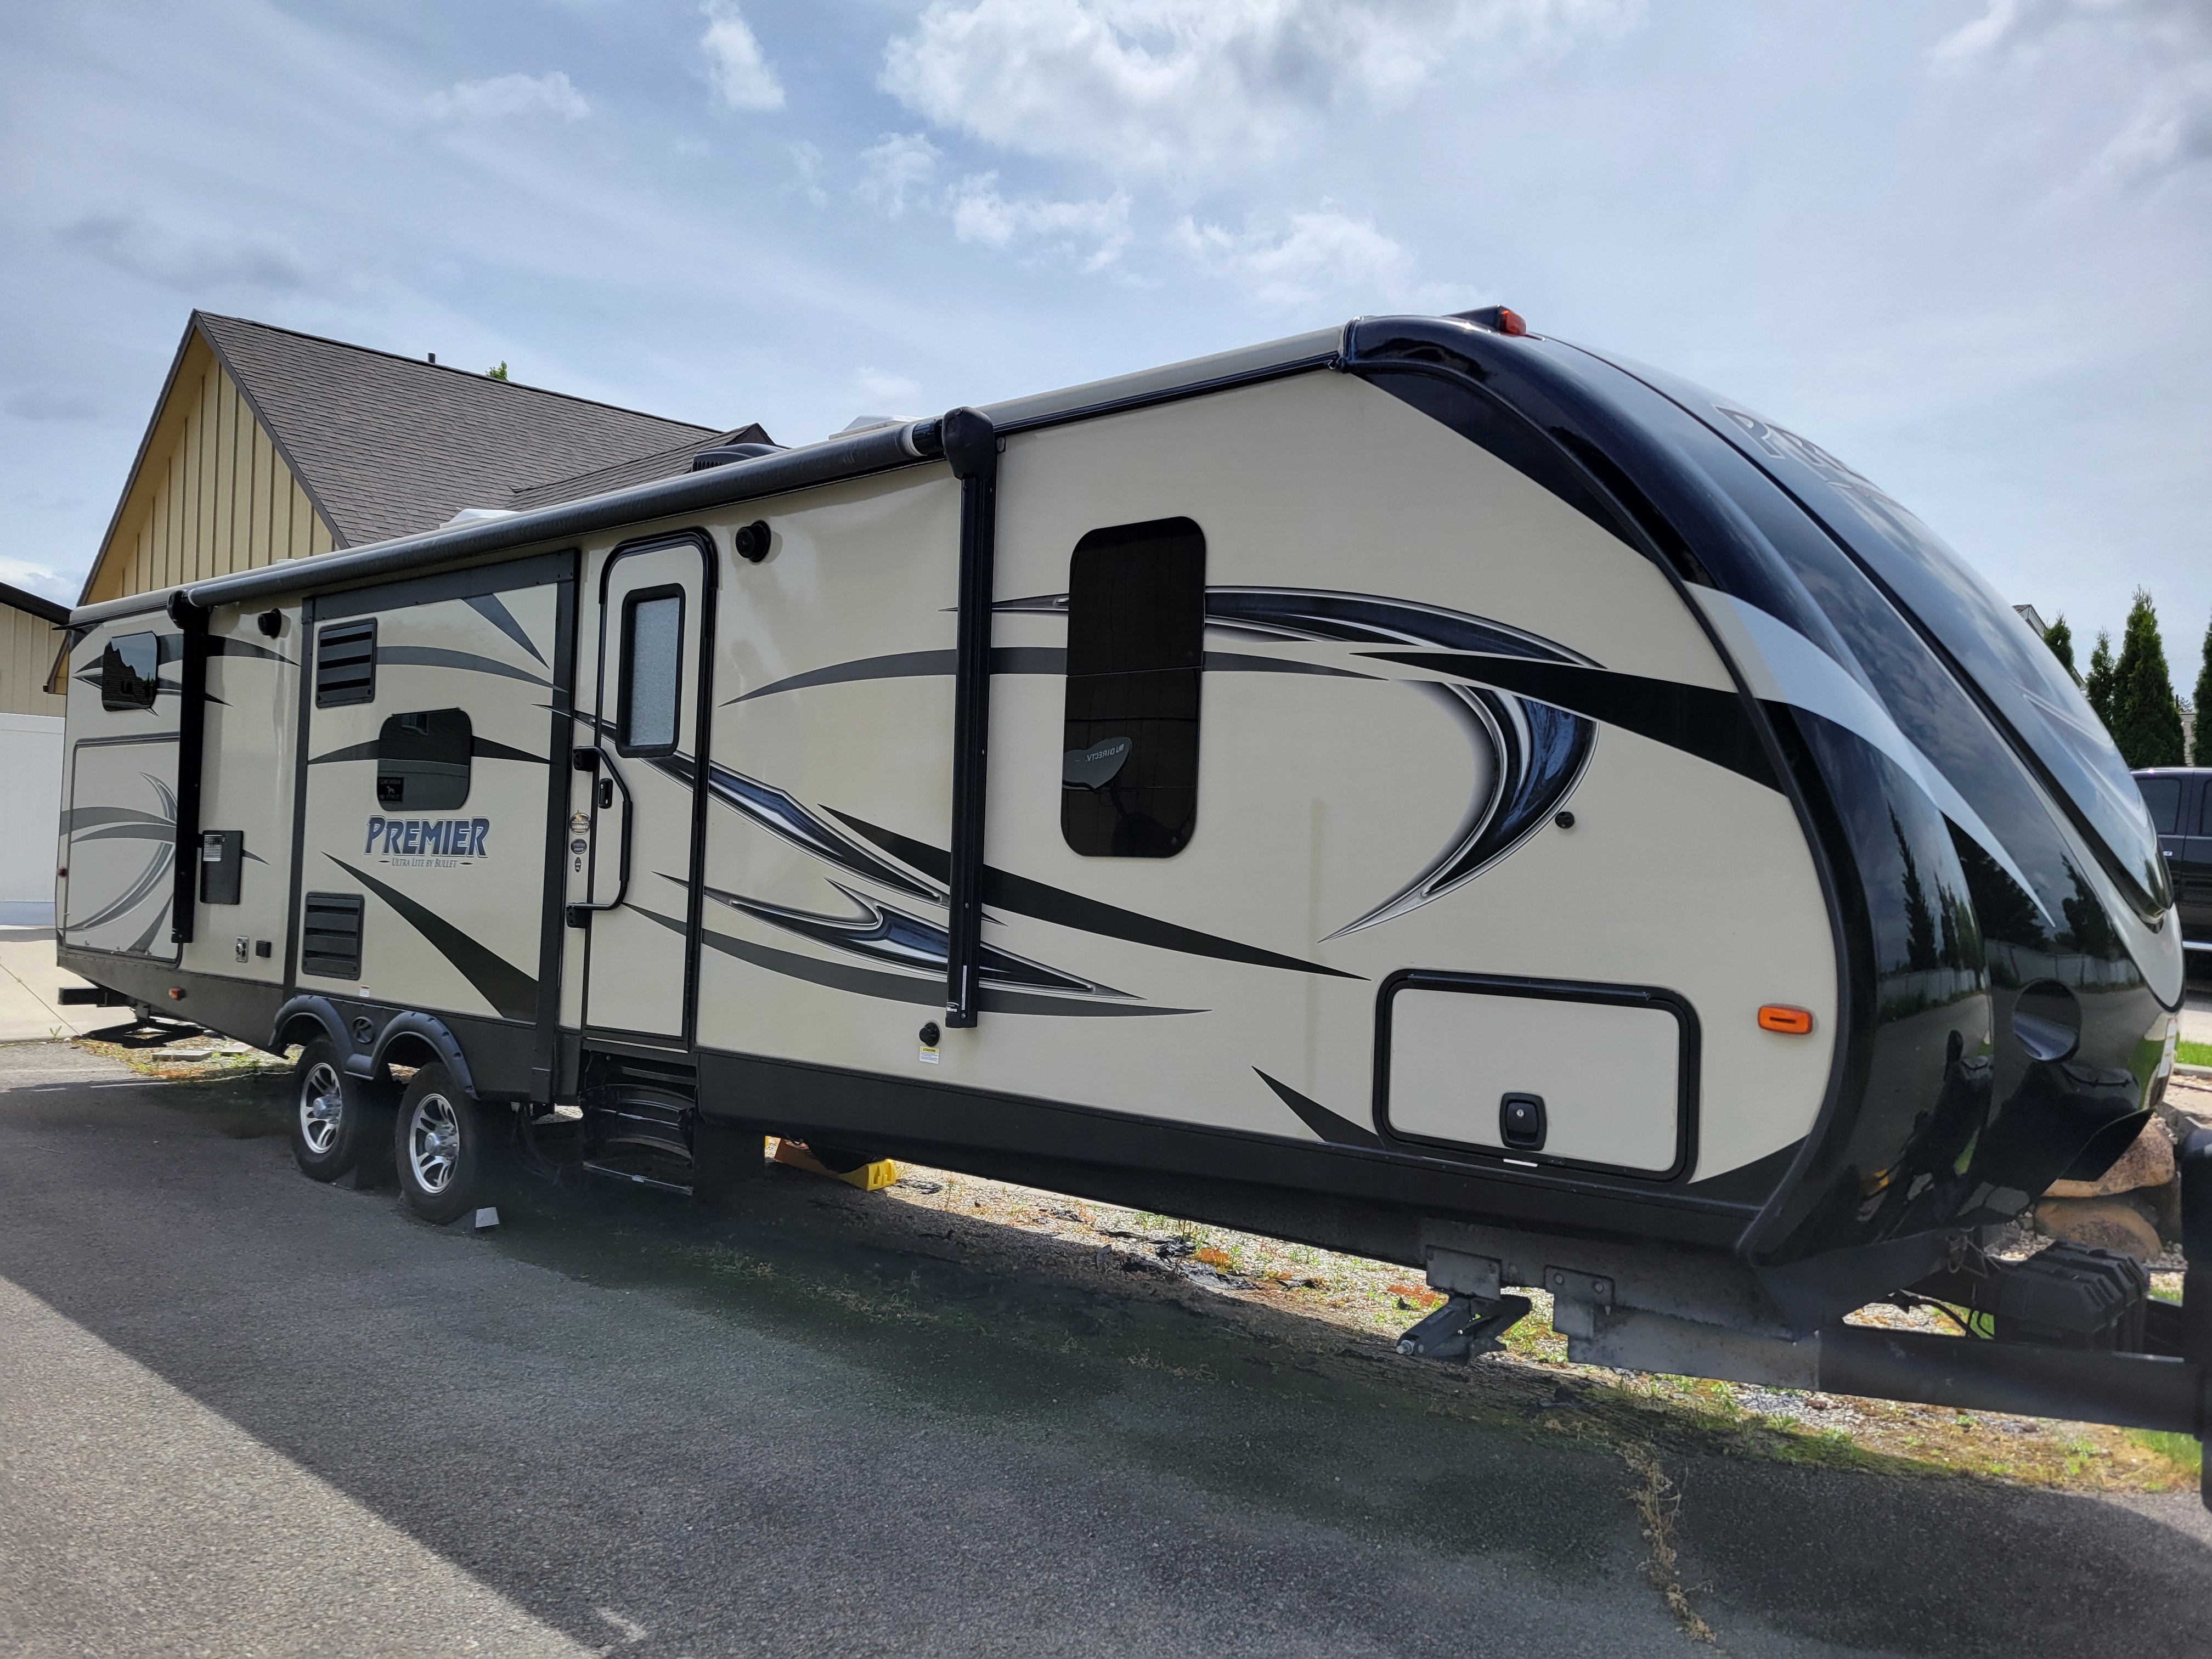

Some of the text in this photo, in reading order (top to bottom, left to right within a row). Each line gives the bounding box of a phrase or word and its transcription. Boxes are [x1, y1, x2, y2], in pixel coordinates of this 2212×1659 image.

[364, 815, 490, 858] PREMIER
[392, 857, 458, 868] ULTRA LITE BY BULLET
